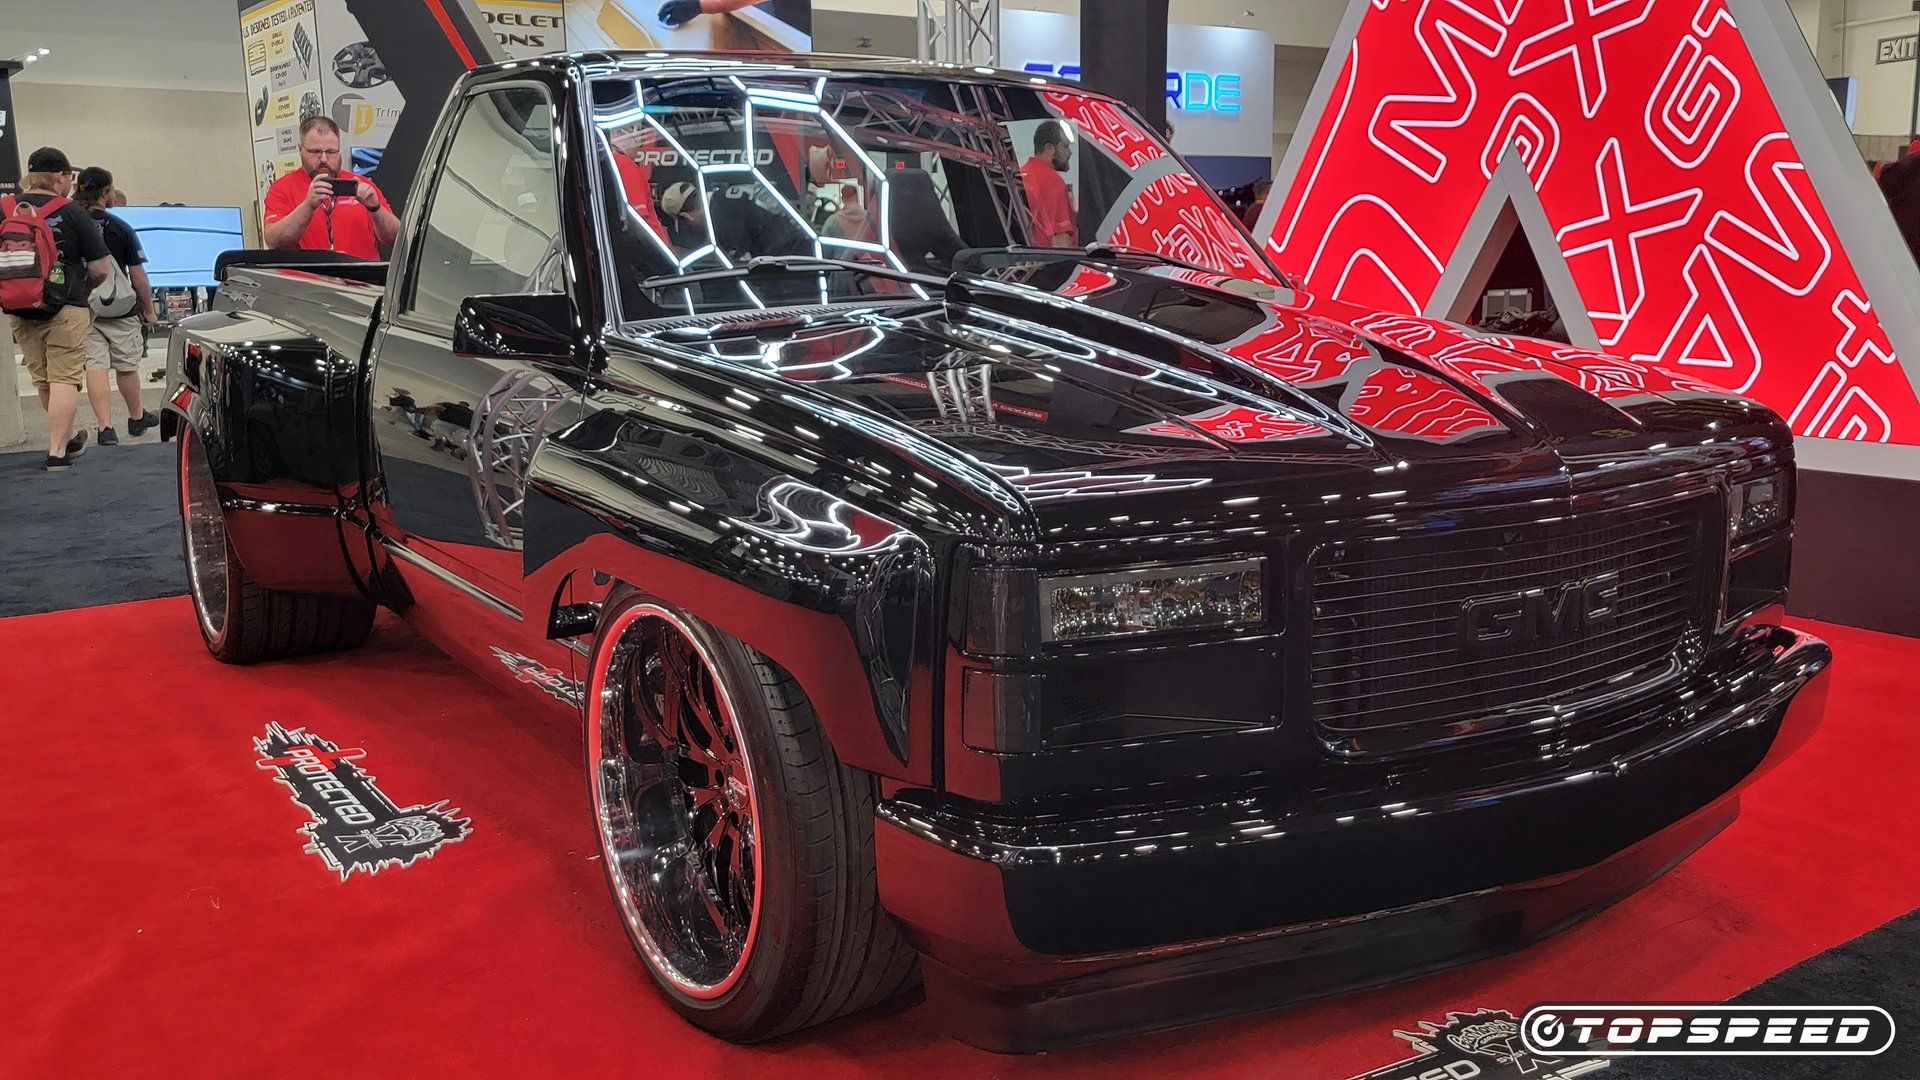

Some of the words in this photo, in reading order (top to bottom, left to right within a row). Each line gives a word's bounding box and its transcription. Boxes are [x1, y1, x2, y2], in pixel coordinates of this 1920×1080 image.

[1880, 37, 1918, 61] EXIT
[1461, 571, 1619, 646] GMC
[283, 748, 376, 825] PROTECTED
